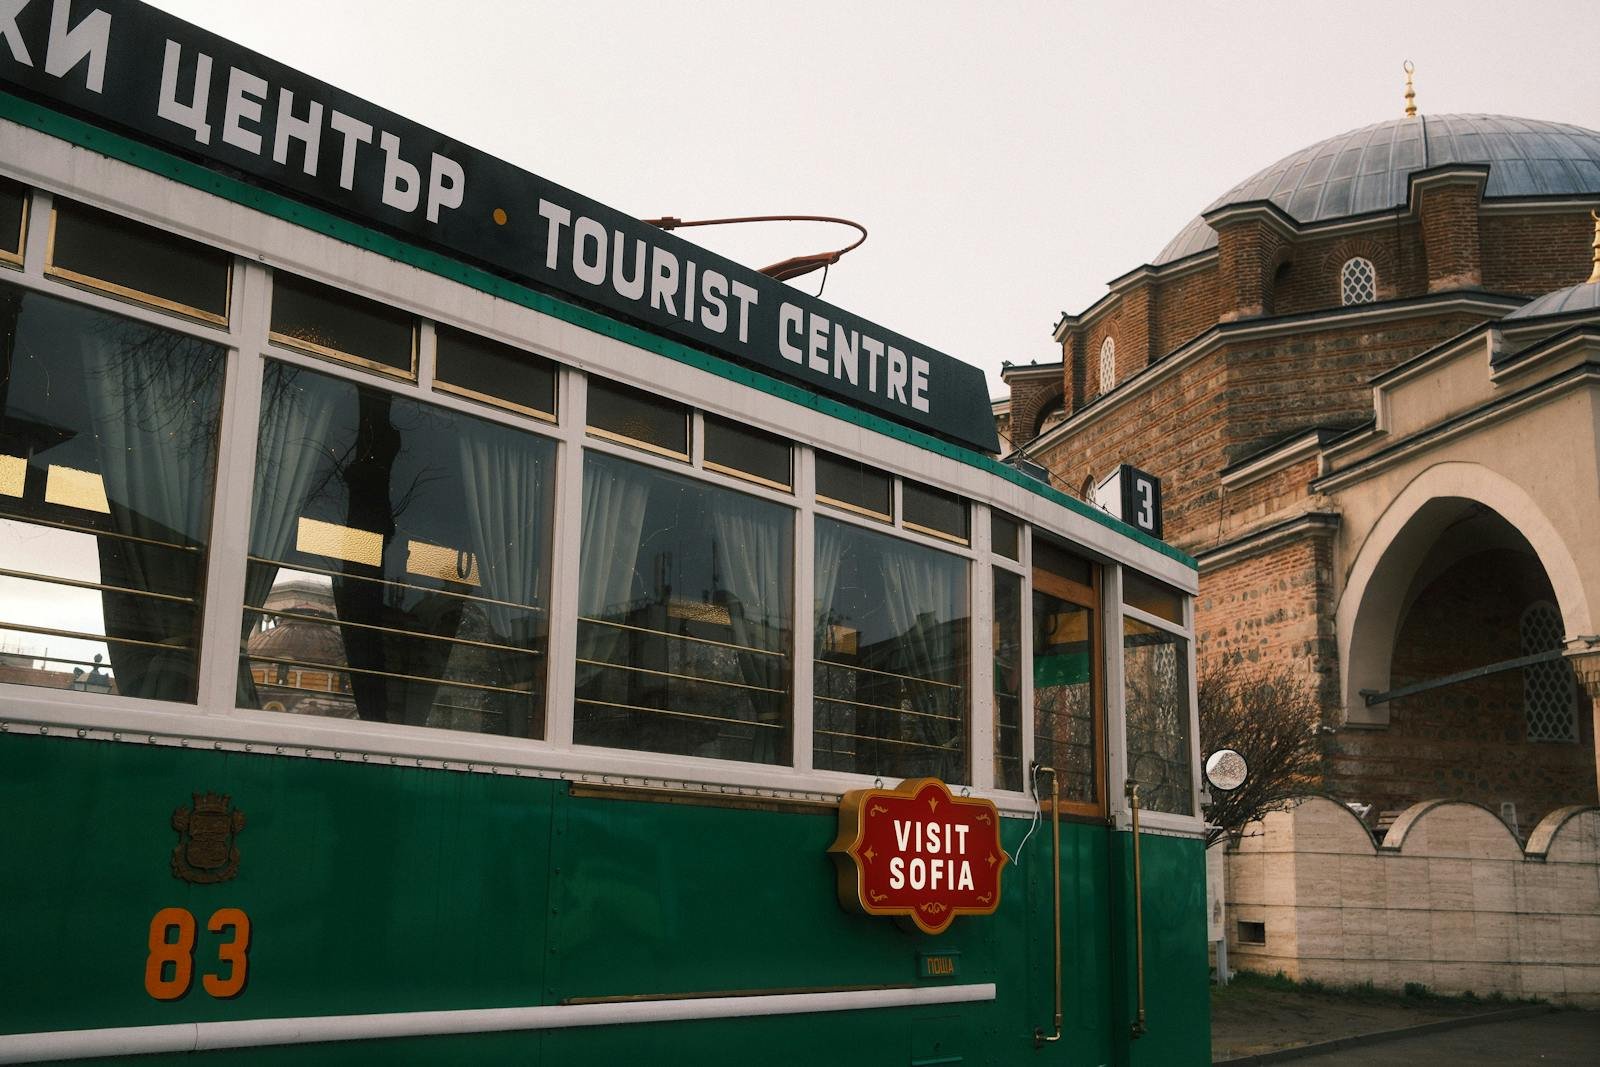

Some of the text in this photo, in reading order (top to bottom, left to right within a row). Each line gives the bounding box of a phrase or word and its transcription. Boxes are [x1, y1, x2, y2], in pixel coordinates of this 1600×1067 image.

[157, 38, 465, 224] ЦЕНТЪР
[539, 198, 930, 414] TOURIST CENTRE
[1136, 478, 1154, 531] 3
[889, 856, 975, 891] SOFIA
[893, 819, 969, 855] VISIT
[145, 907, 250, 1000] 83
